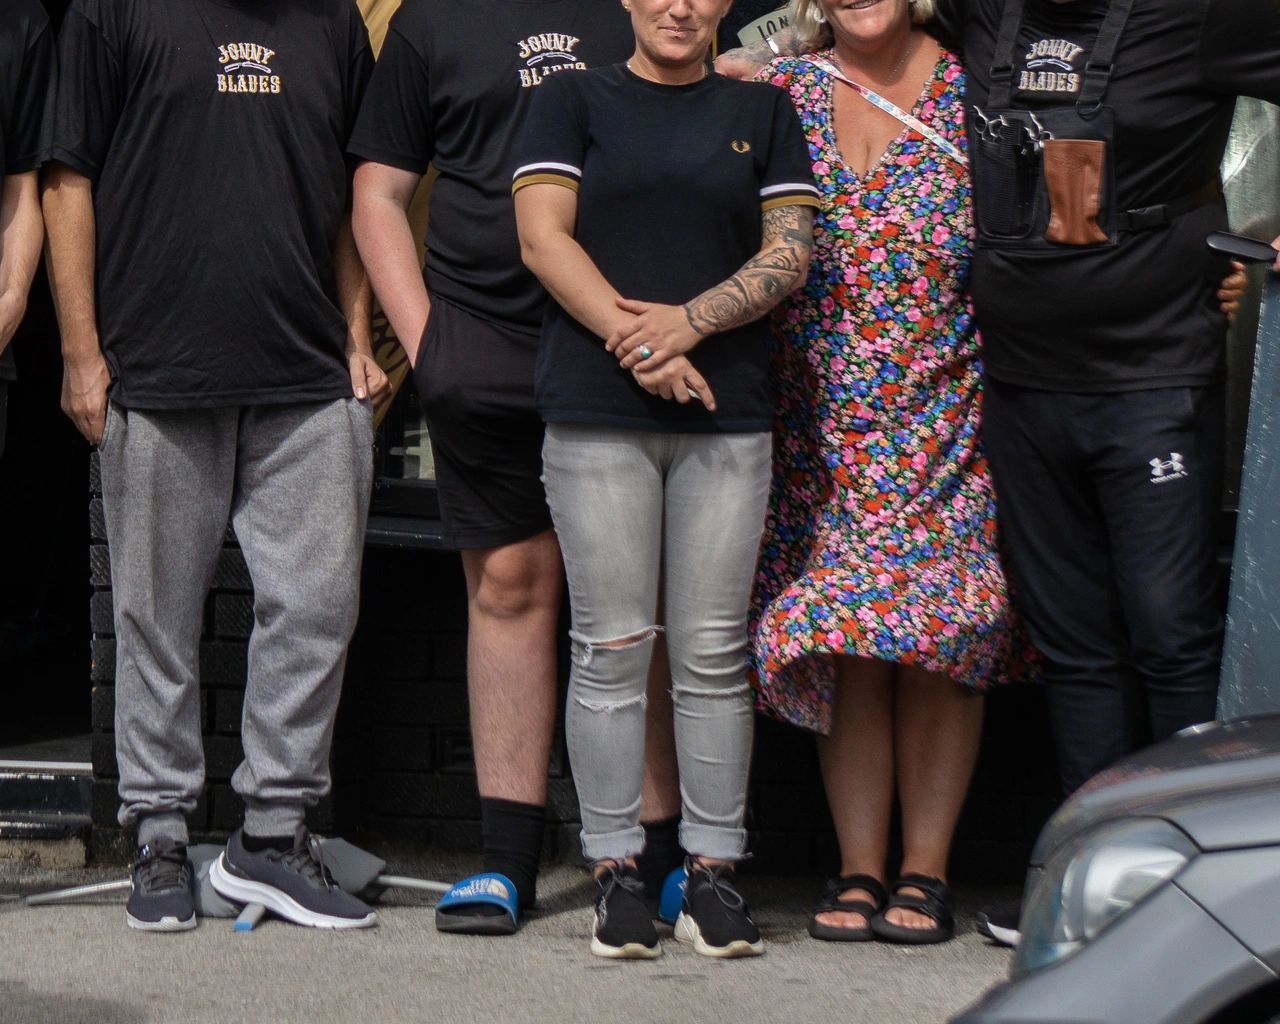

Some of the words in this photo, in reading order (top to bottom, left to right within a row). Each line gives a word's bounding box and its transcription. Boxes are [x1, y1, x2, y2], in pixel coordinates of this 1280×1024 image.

[218, 42, 275, 64] JONNY
[517, 32, 580, 58] JONNY
[1025, 39, 1084, 62] JONNY
[216, 74, 280, 93] BLADES
[1018, 71, 1080, 92] BLADES
